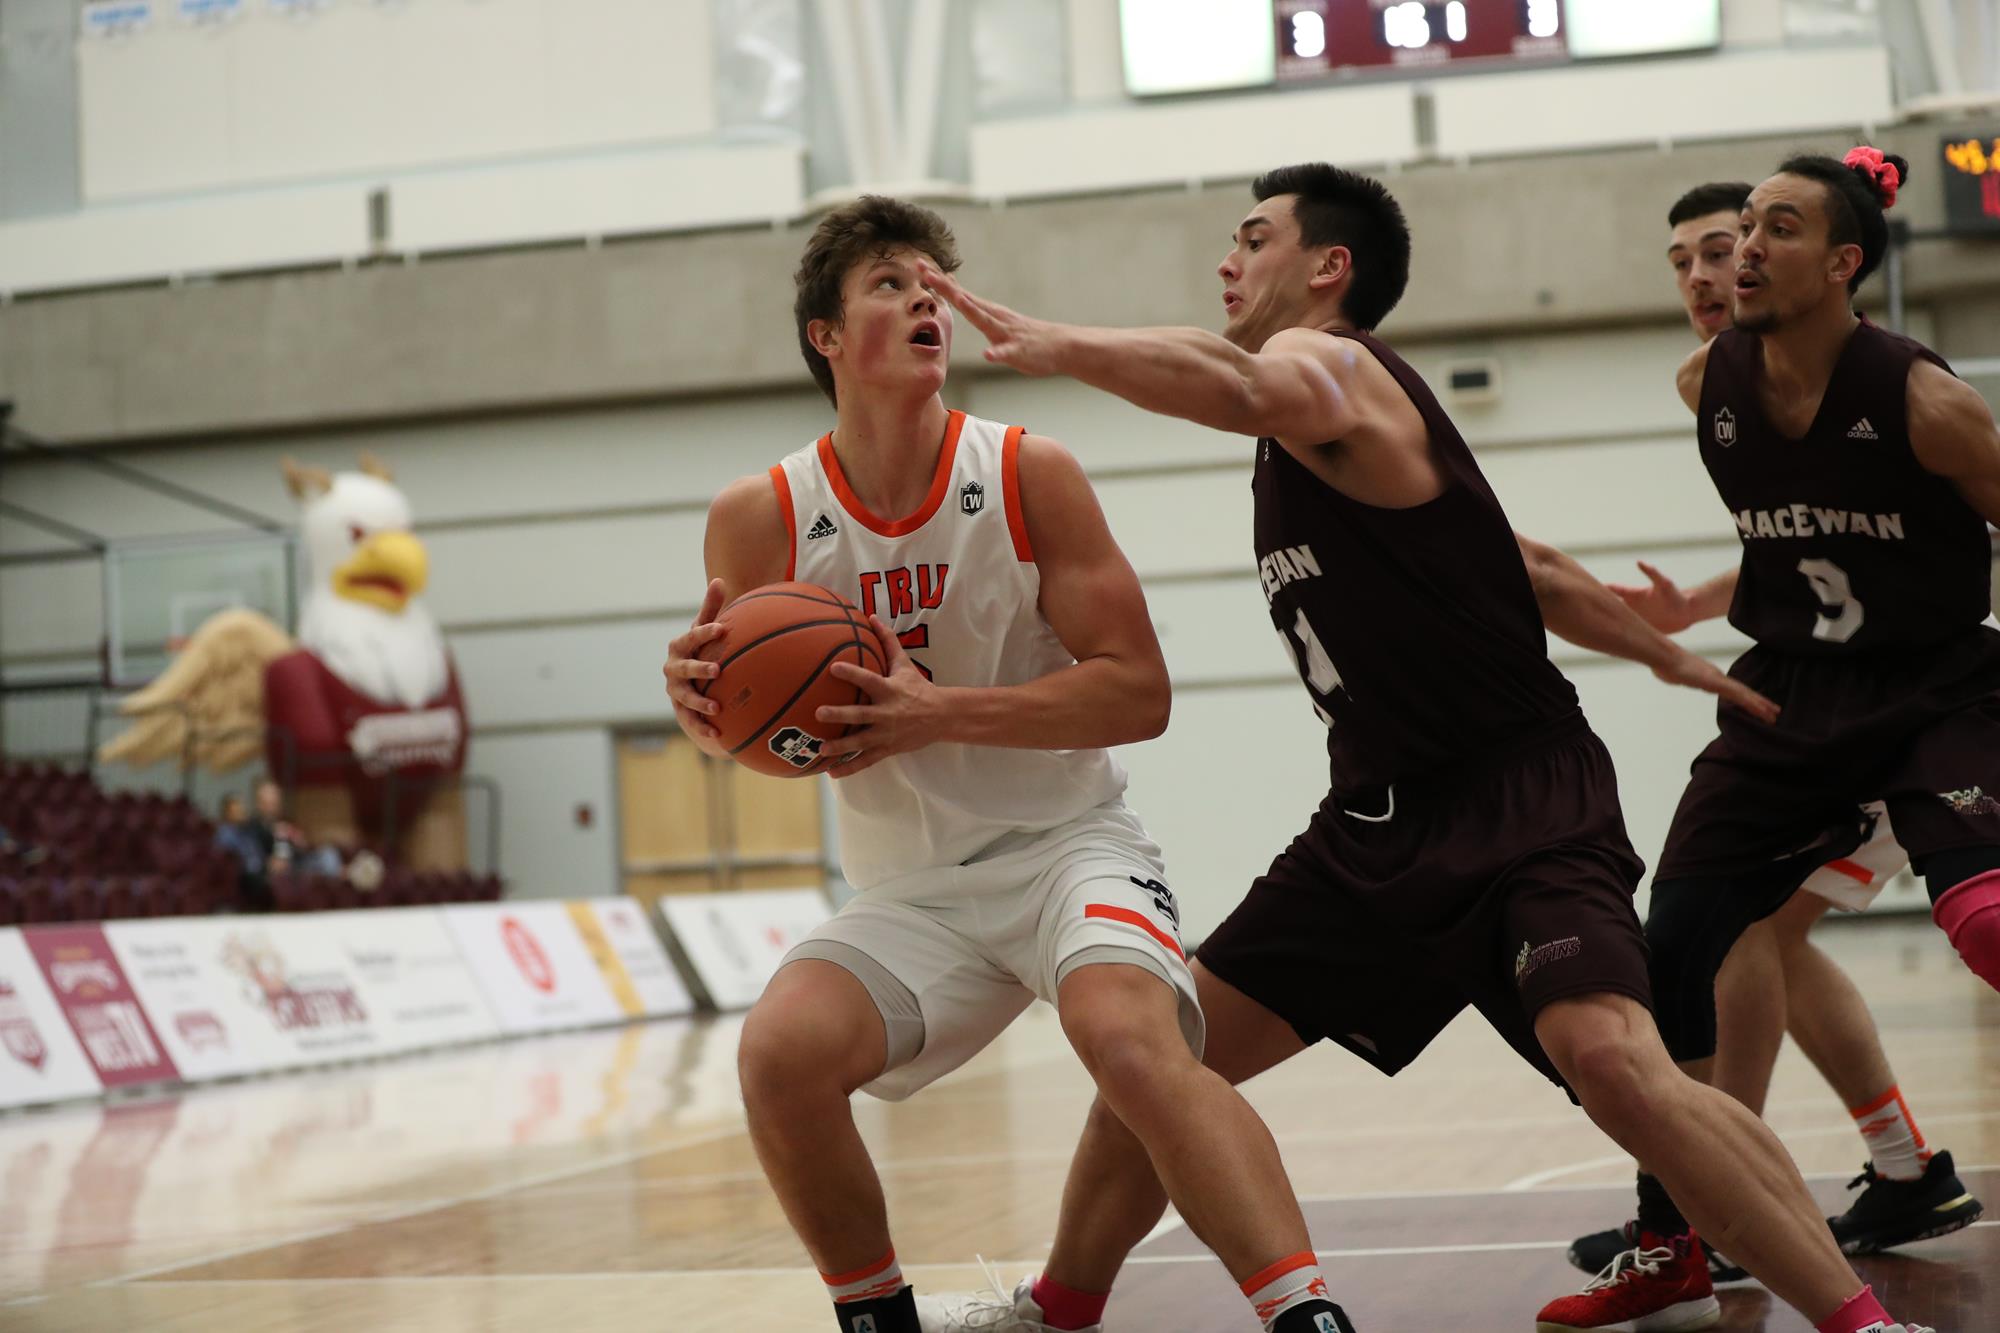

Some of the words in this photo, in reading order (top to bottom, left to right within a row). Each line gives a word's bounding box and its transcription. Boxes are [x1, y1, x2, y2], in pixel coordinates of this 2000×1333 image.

[1717, 421, 1733, 440] CW
[1847, 430, 1879, 440] adidas
[963, 493, 983, 511] CW
[1732, 503, 1905, 540] MACEWAN
[807, 525, 838, 540] adidas
[859, 563, 949, 619] TRU
